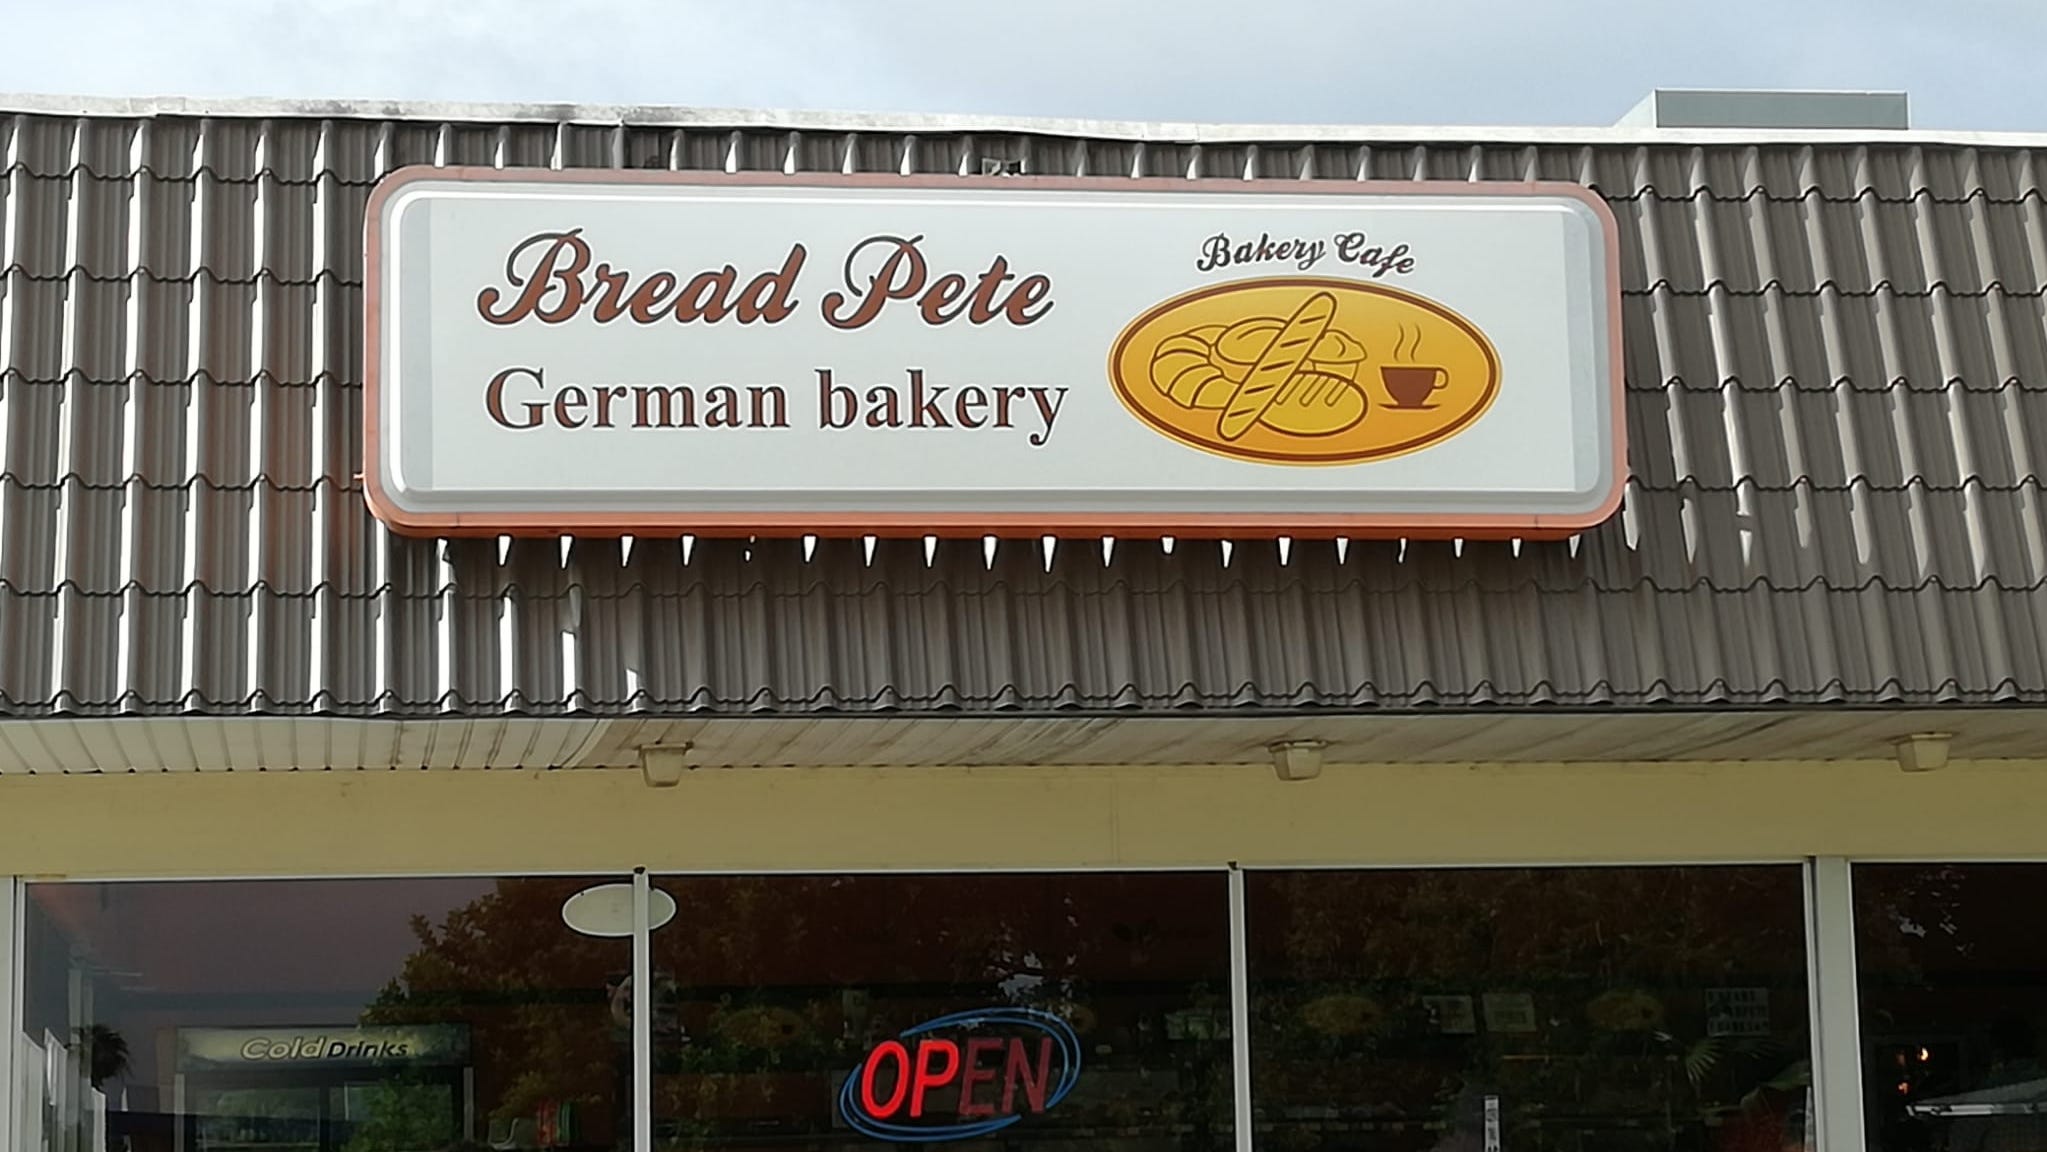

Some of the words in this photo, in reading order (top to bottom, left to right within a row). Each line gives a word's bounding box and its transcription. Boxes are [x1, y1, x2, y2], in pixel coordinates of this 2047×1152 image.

[477, 228, 807, 325] Bread
[821, 234, 1055, 330] Pete
[1197, 233, 1326, 271] Bakery
[1333, 232, 1415, 278] Cafe
[486, 367, 791, 430] German
[815, 368, 1069, 446] bakery
[241, 1037, 326, 1061] Cold
[326, 1041, 409, 1060] Drinks
[861, 1037, 1053, 1118] OPEN
